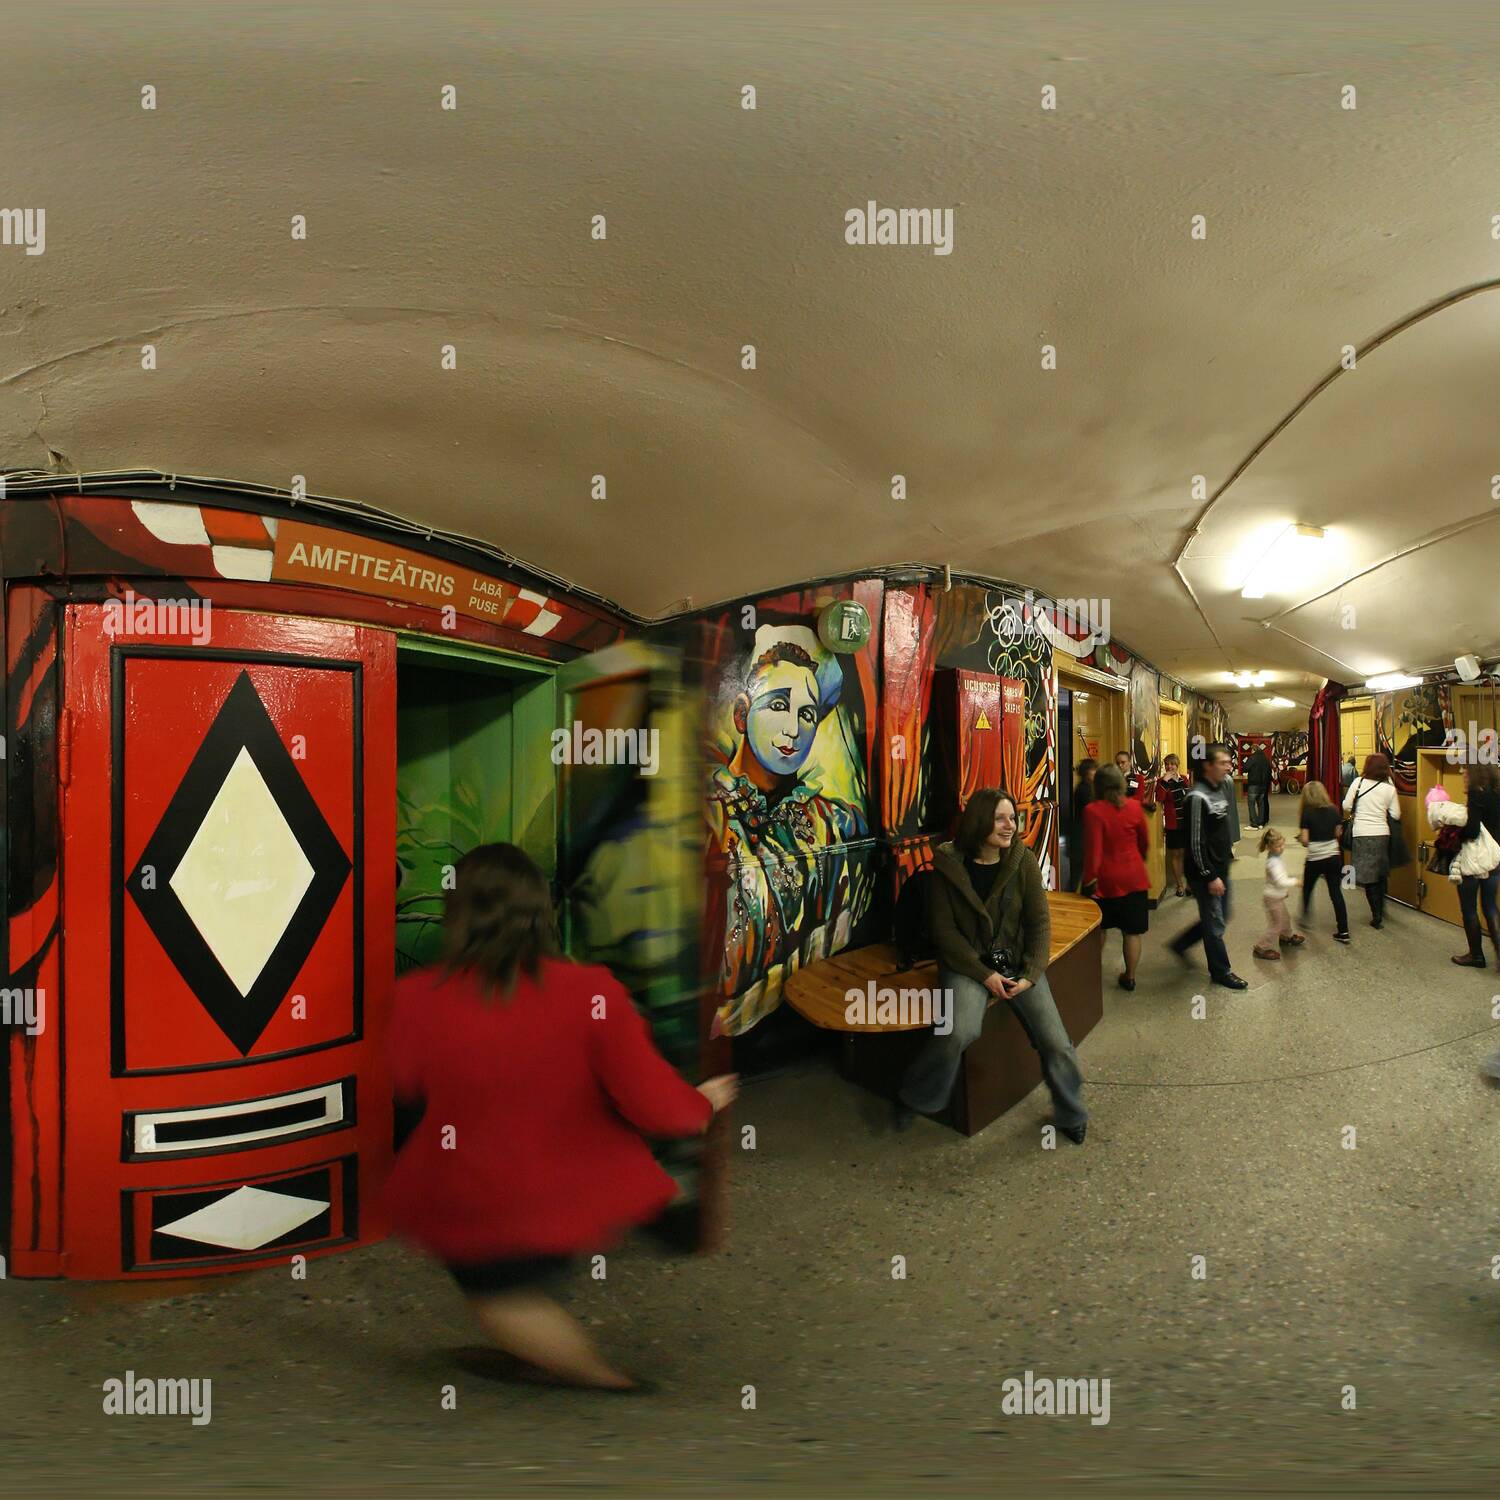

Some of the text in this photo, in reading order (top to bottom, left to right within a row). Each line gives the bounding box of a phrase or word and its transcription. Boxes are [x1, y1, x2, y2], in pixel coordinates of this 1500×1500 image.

[287, 543, 455, 596] AMFITEĀTRIS
[472, 578, 503, 598] LABĀ
[469, 596, 498, 615] PUSE
